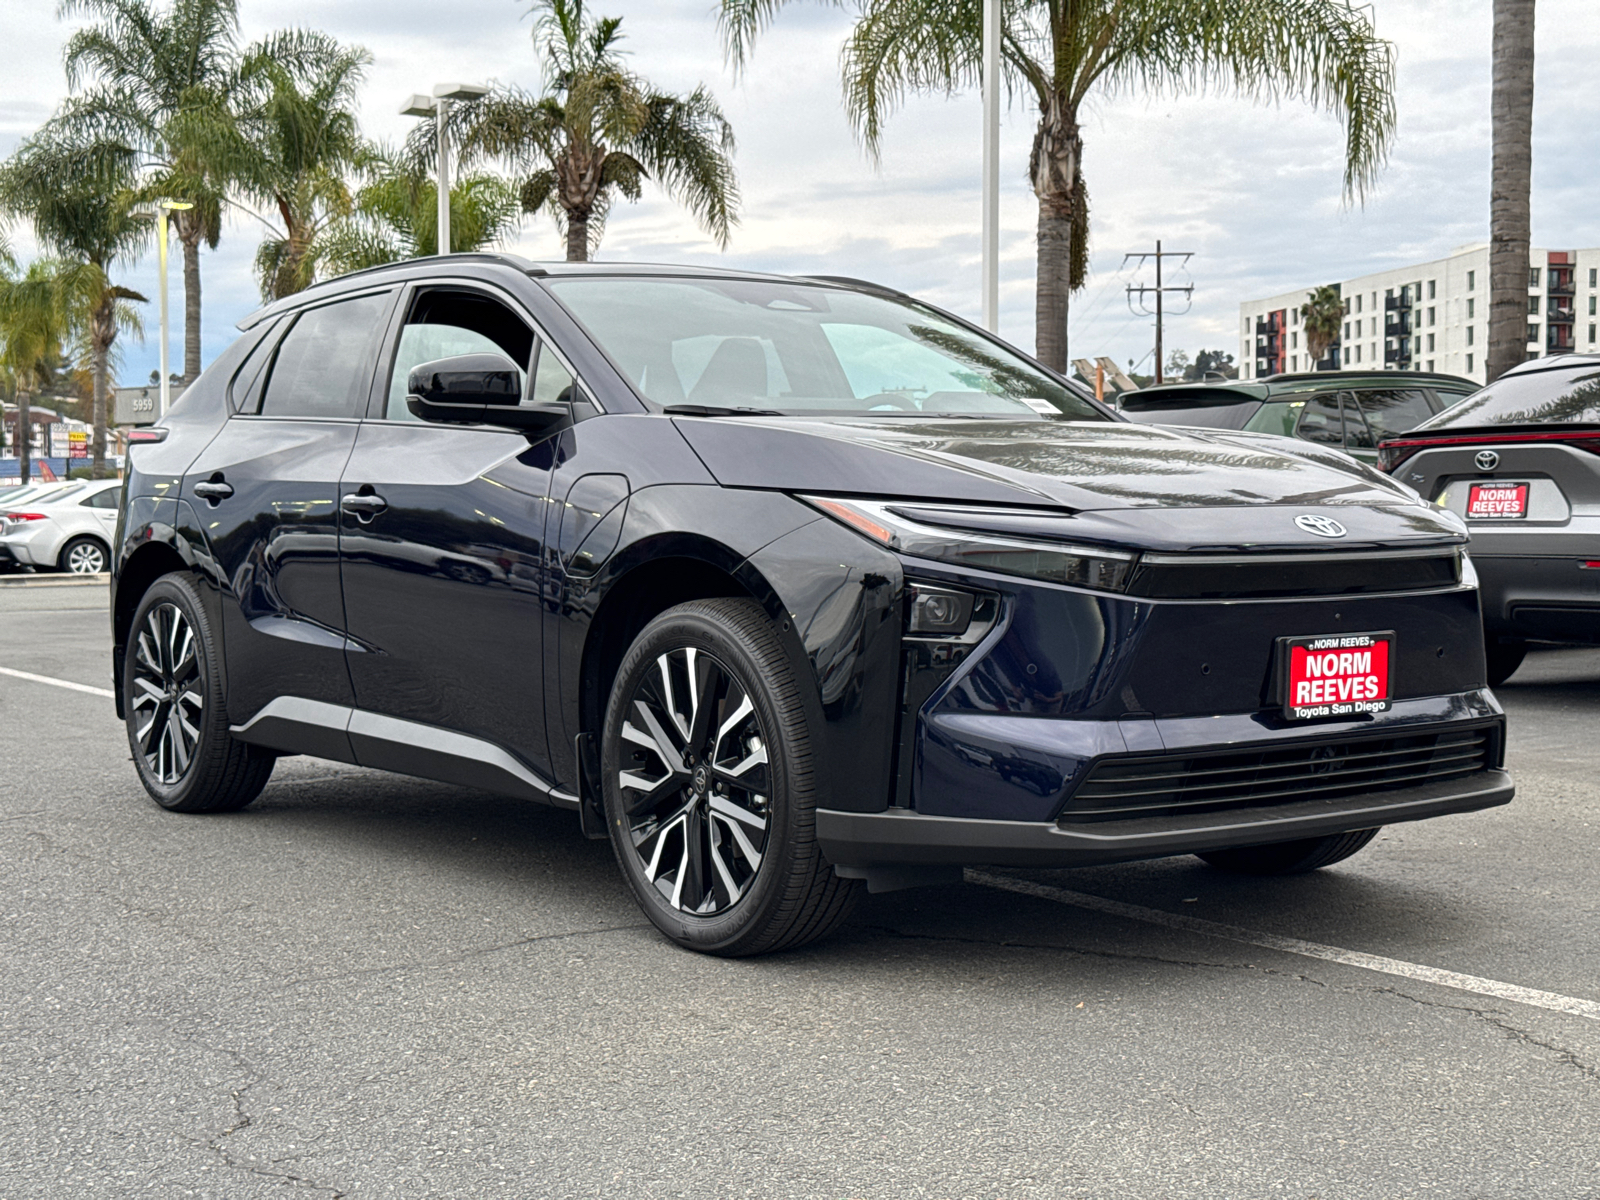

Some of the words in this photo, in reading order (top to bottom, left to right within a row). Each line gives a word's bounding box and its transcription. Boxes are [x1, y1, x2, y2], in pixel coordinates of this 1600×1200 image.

[133, 398, 153, 411] 5959
[1479, 489, 1517, 501] NORM
[1472, 500, 1520, 512] REEVES
[1314, 638, 1339, 650] NORM
[1340, 636, 1370, 648] REEVES
[1306, 651, 1372, 678] NORM
[1296, 675, 1379, 704] REEVES
[1294, 705, 1329, 719] Toyota
[1332, 703, 1352, 714] San
[1355, 701, 1386, 712] Diego
